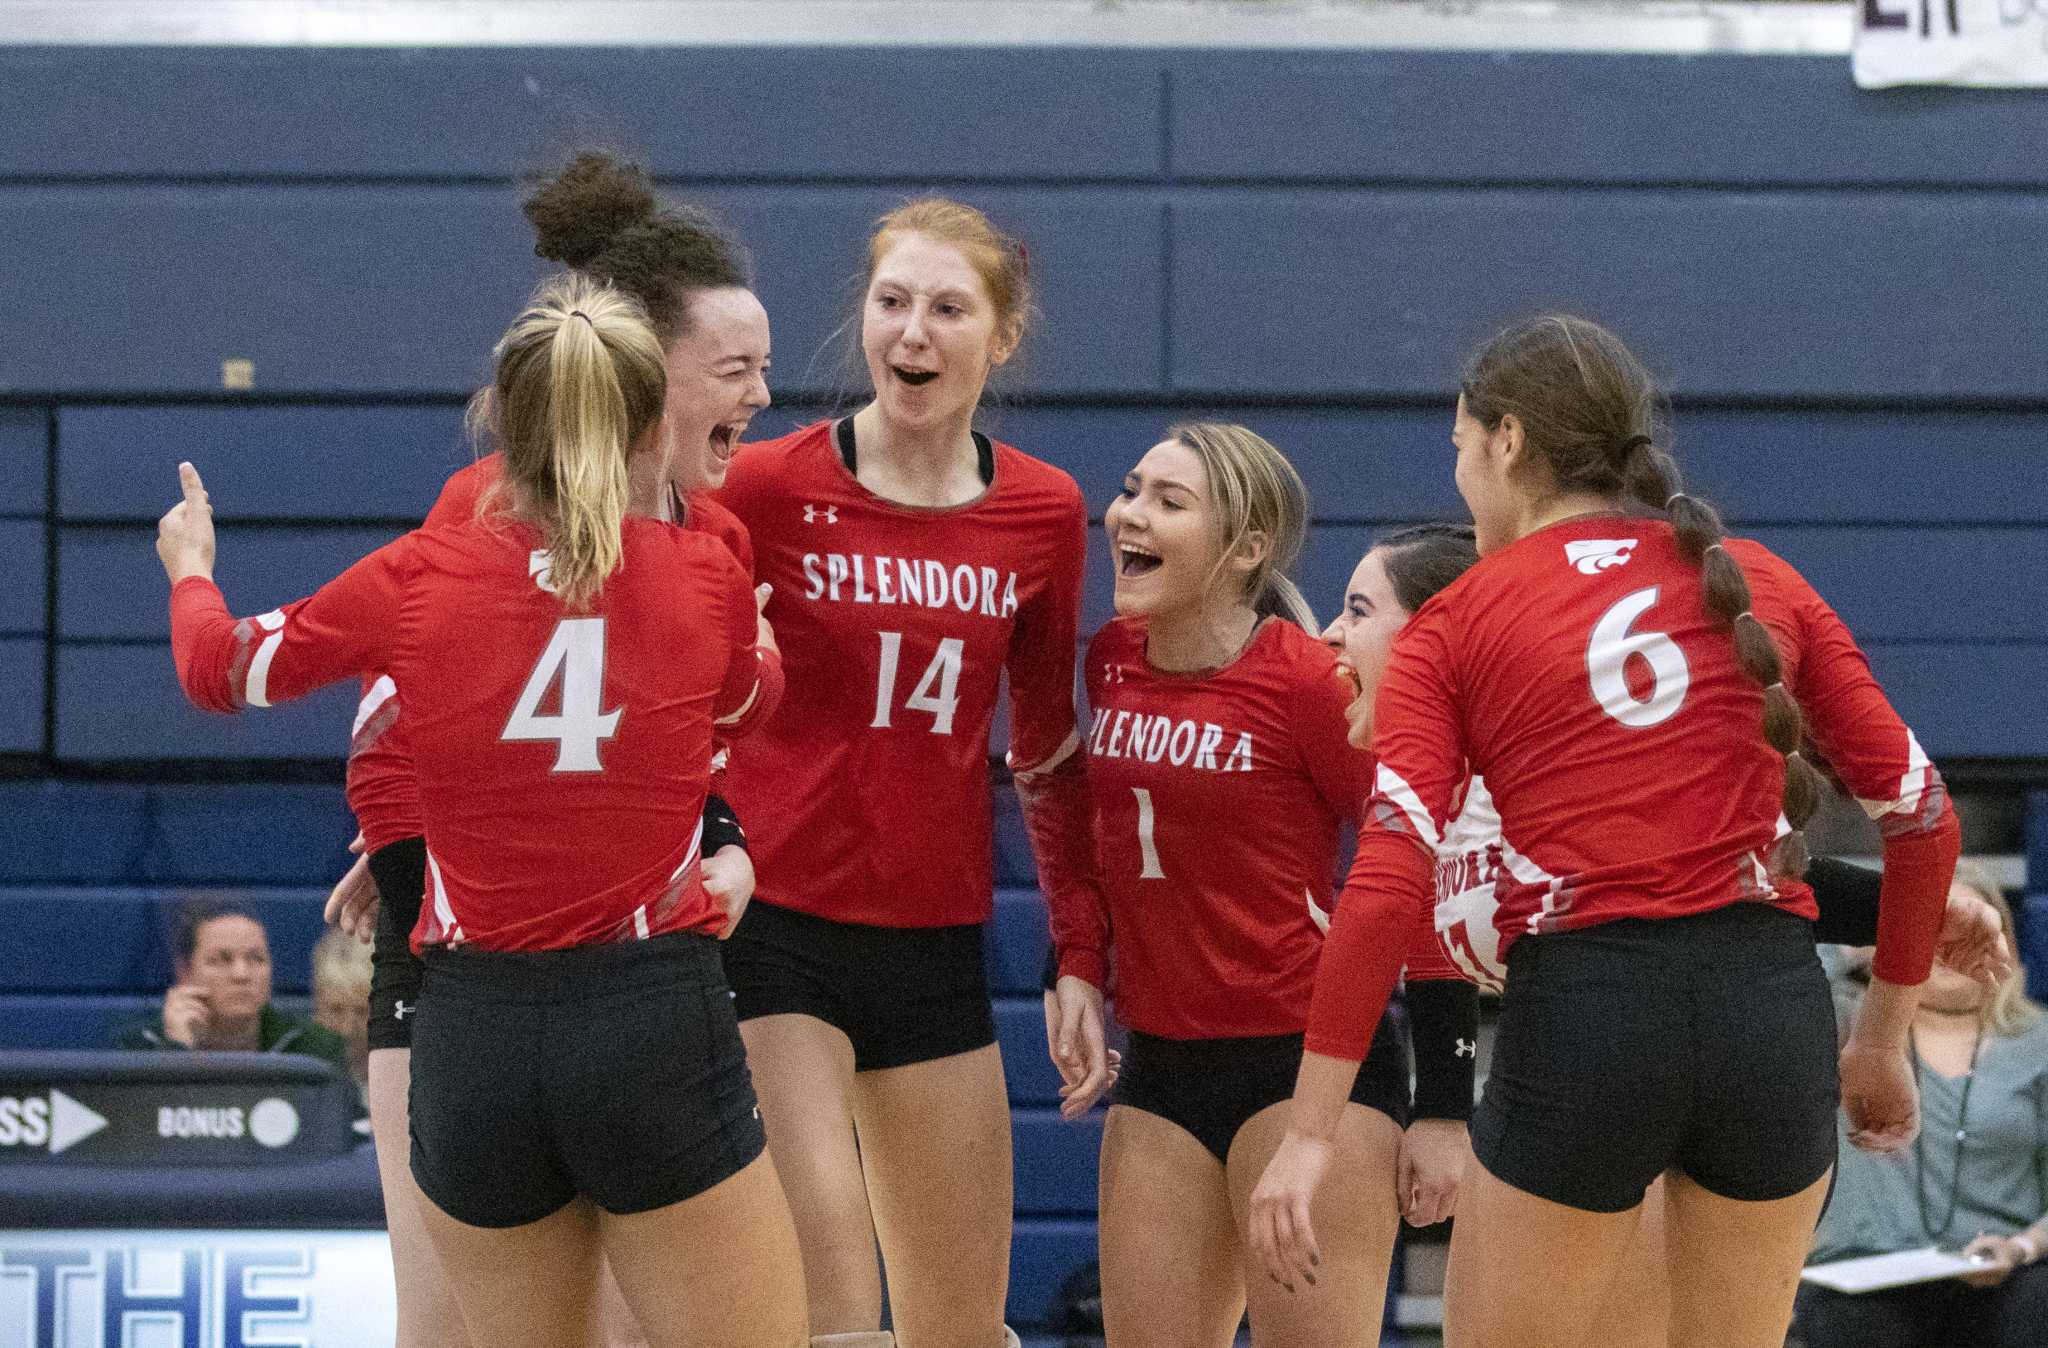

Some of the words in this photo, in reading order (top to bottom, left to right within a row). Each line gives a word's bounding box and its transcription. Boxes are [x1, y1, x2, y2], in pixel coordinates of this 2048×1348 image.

[803, 553, 1019, 618] SPLENDORA
[499, 616, 624, 773] 4
[869, 631, 965, 735] 14
[1586, 584, 1691, 728] 6
[1131, 787, 1167, 879] 1
[157, 1106, 245, 1138] BONUS
[0, 1248, 312, 1348] THE
